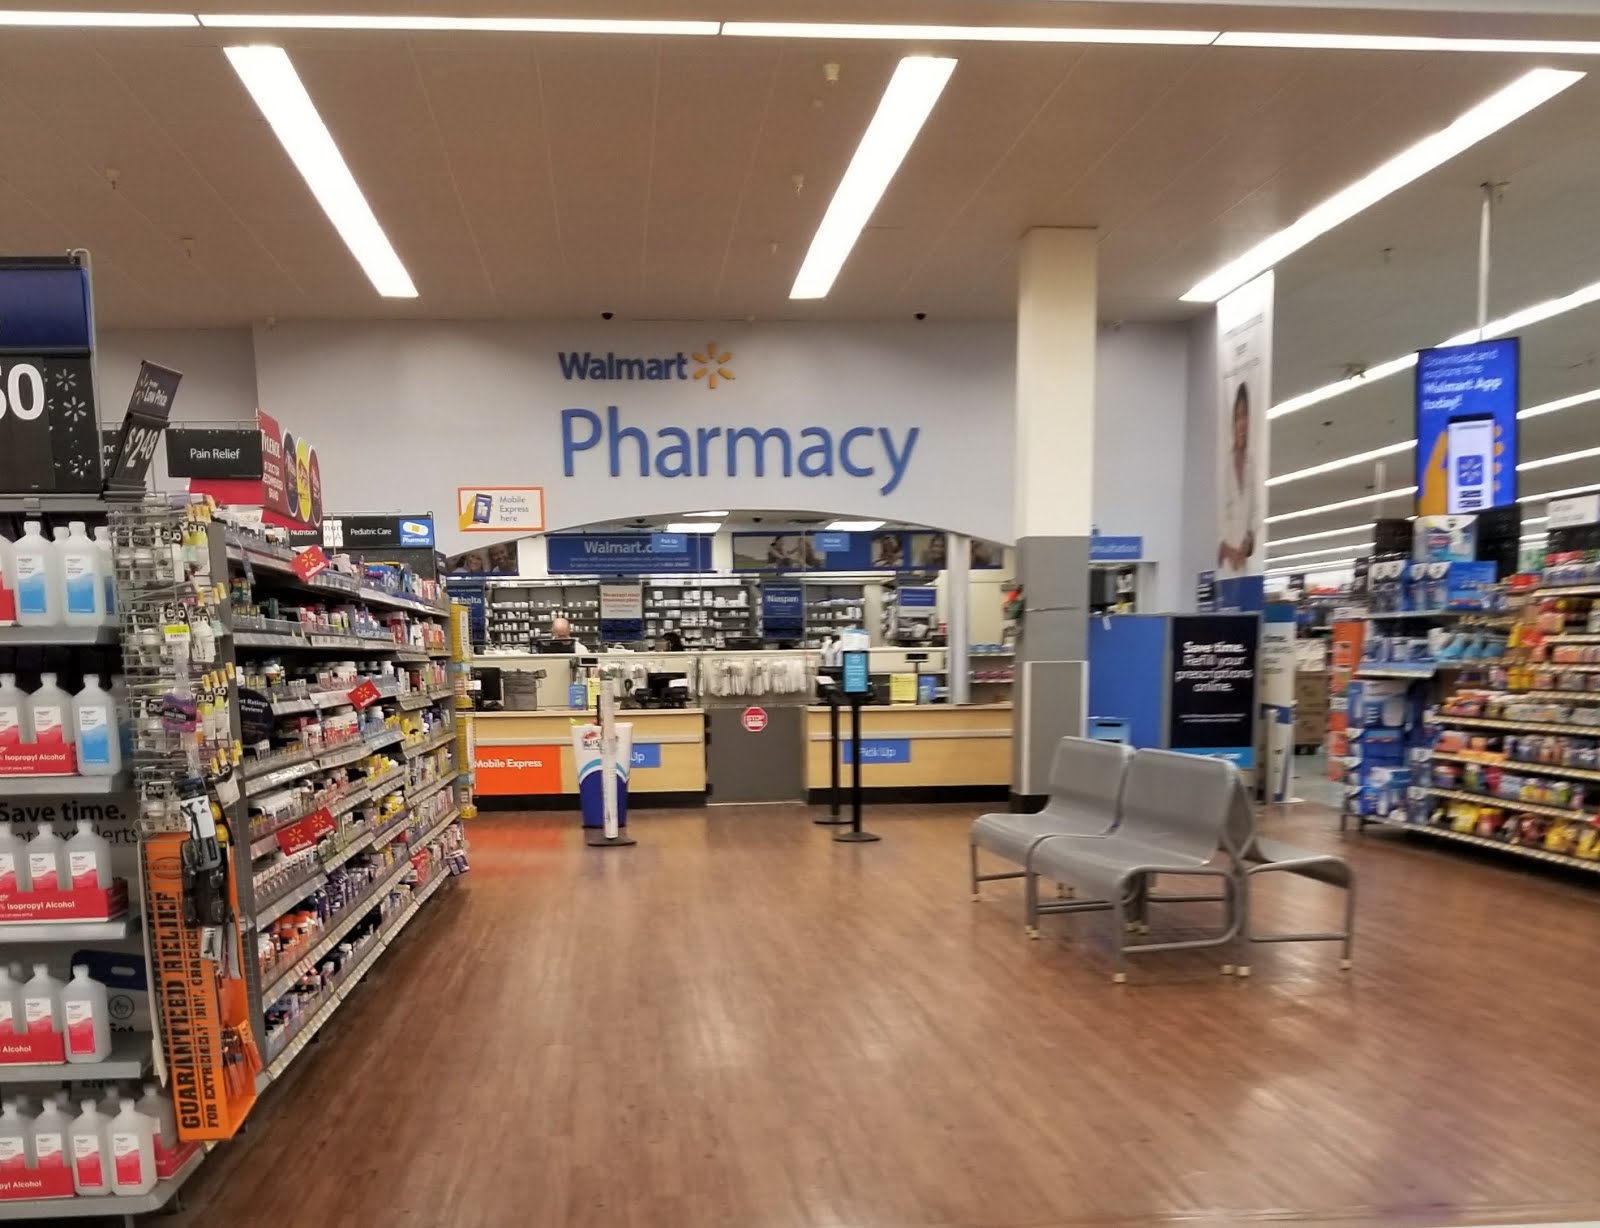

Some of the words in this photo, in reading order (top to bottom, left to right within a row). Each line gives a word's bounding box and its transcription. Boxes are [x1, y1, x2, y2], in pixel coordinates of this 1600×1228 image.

[559, 351, 688, 381] Walmart
[1423, 379, 1474, 394] Walmart
[1474, 376, 1502, 392] App
[0, 363, 45, 421] 0
[190, 448, 210, 459] Pain
[212, 447, 240, 459] Relief
[561, 406, 920, 496] Pharmacy
[500, 495, 526, 504] Mobile
[500, 505, 529, 515] Express
[500, 514, 518, 522] here
[584, 541, 653, 554] Walmart.c
[1182, 640, 1213, 653] Save
[4, 754, 38, 762] Isopropyl
[474, 759, 506, 768] Mobile
[507, 759, 543, 770] Express
[0, 801, 56, 822] Save
[61, 800, 127, 821] time.
[7, 902, 44, 910] Isopropyl
[45, 900, 75, 909] Alcohol
[156, 891, 184, 973] RELIEF
[186, 929, 203, 986] CRACKE
[3, 1044, 31, 1053] Alcohol
[165, 980, 202, 1129] GUARANTEED
[194, 1025, 217, 1100] EXTREMELY
[206, 1104, 219, 1128] FOR
[13, 1180, 42, 1190] Alcohol
